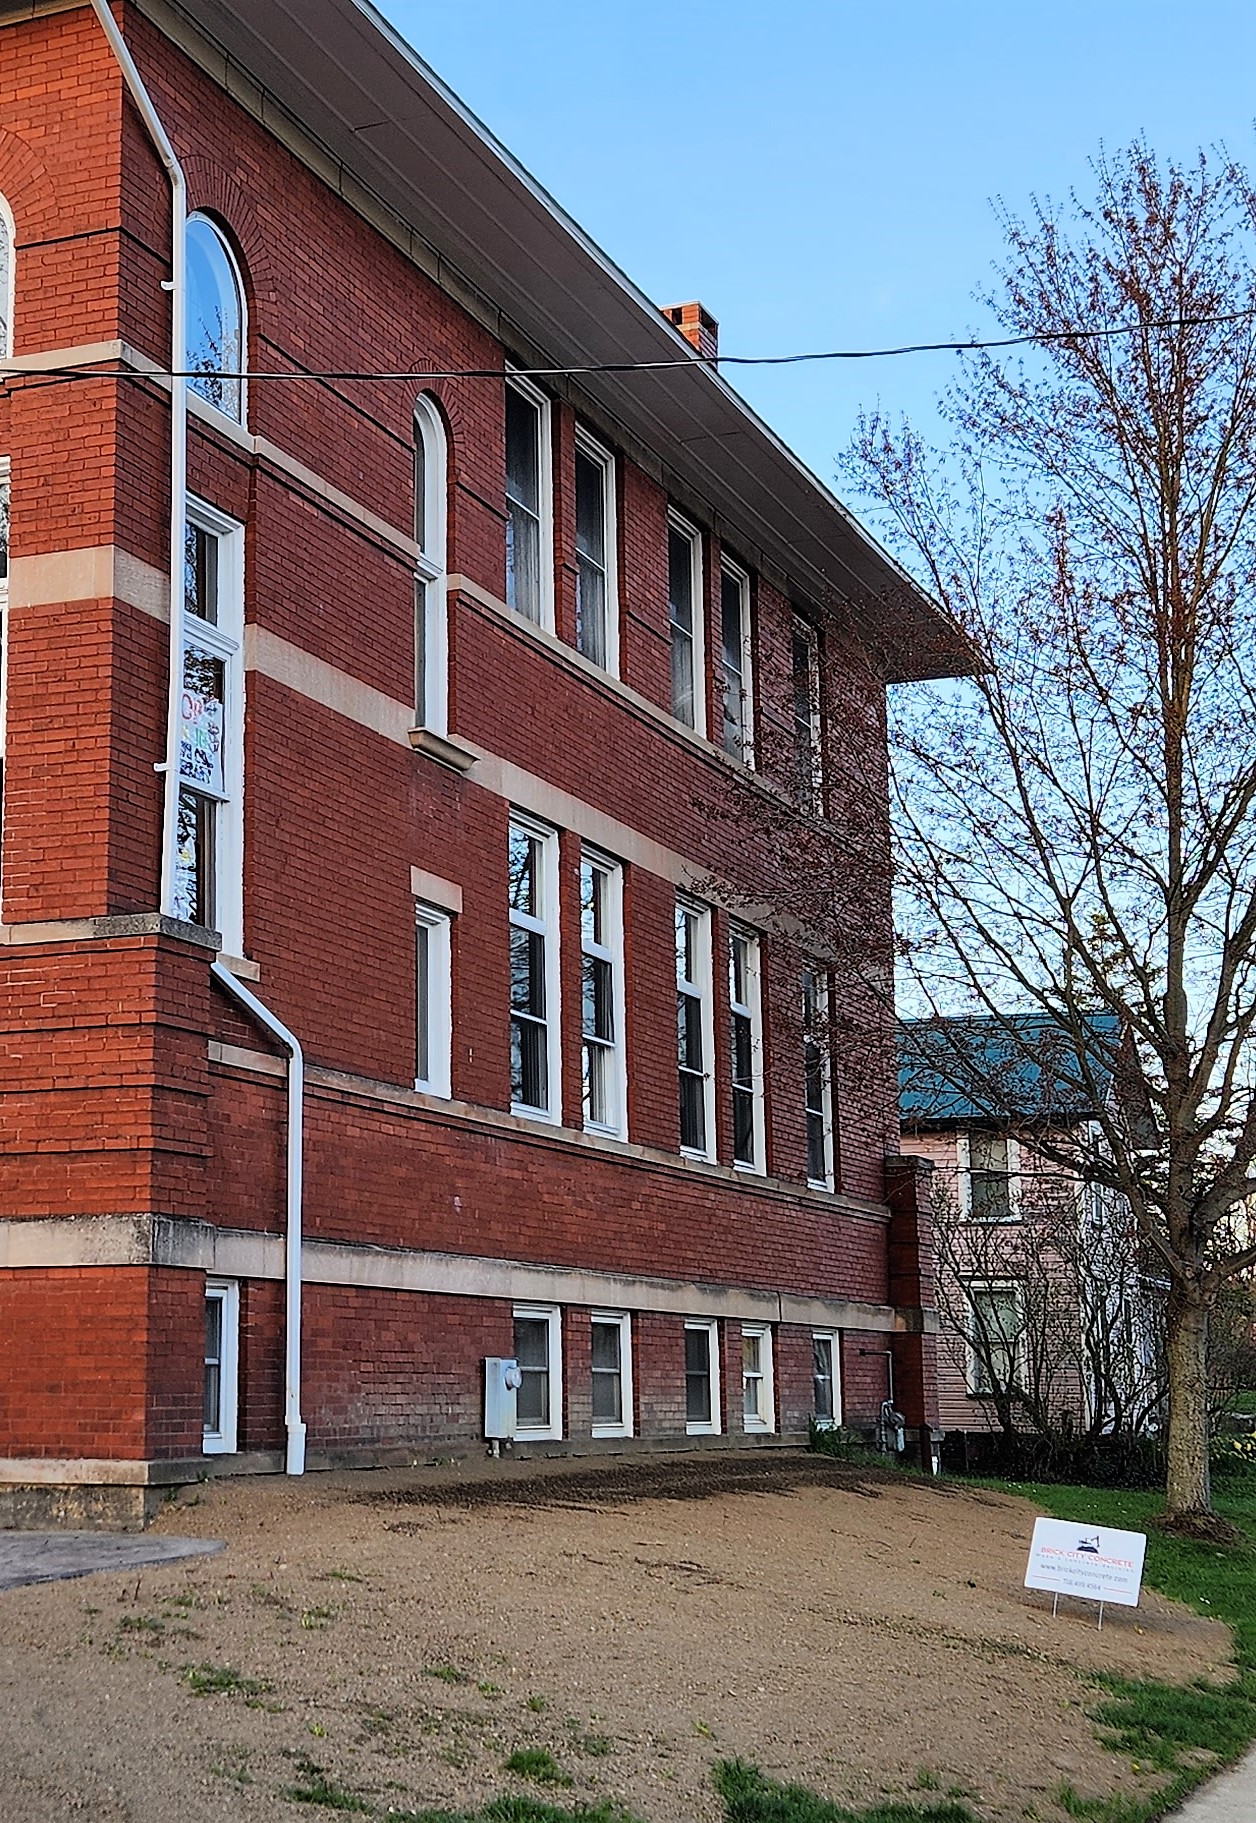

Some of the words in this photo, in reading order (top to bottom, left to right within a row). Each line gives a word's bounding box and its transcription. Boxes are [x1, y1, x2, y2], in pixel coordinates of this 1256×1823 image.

[1040, 1546, 1065, 1557] BRICK
[1066, 1550, 1086, 1559] CITY
[1087, 1554, 1134, 1568] CONCRETE
